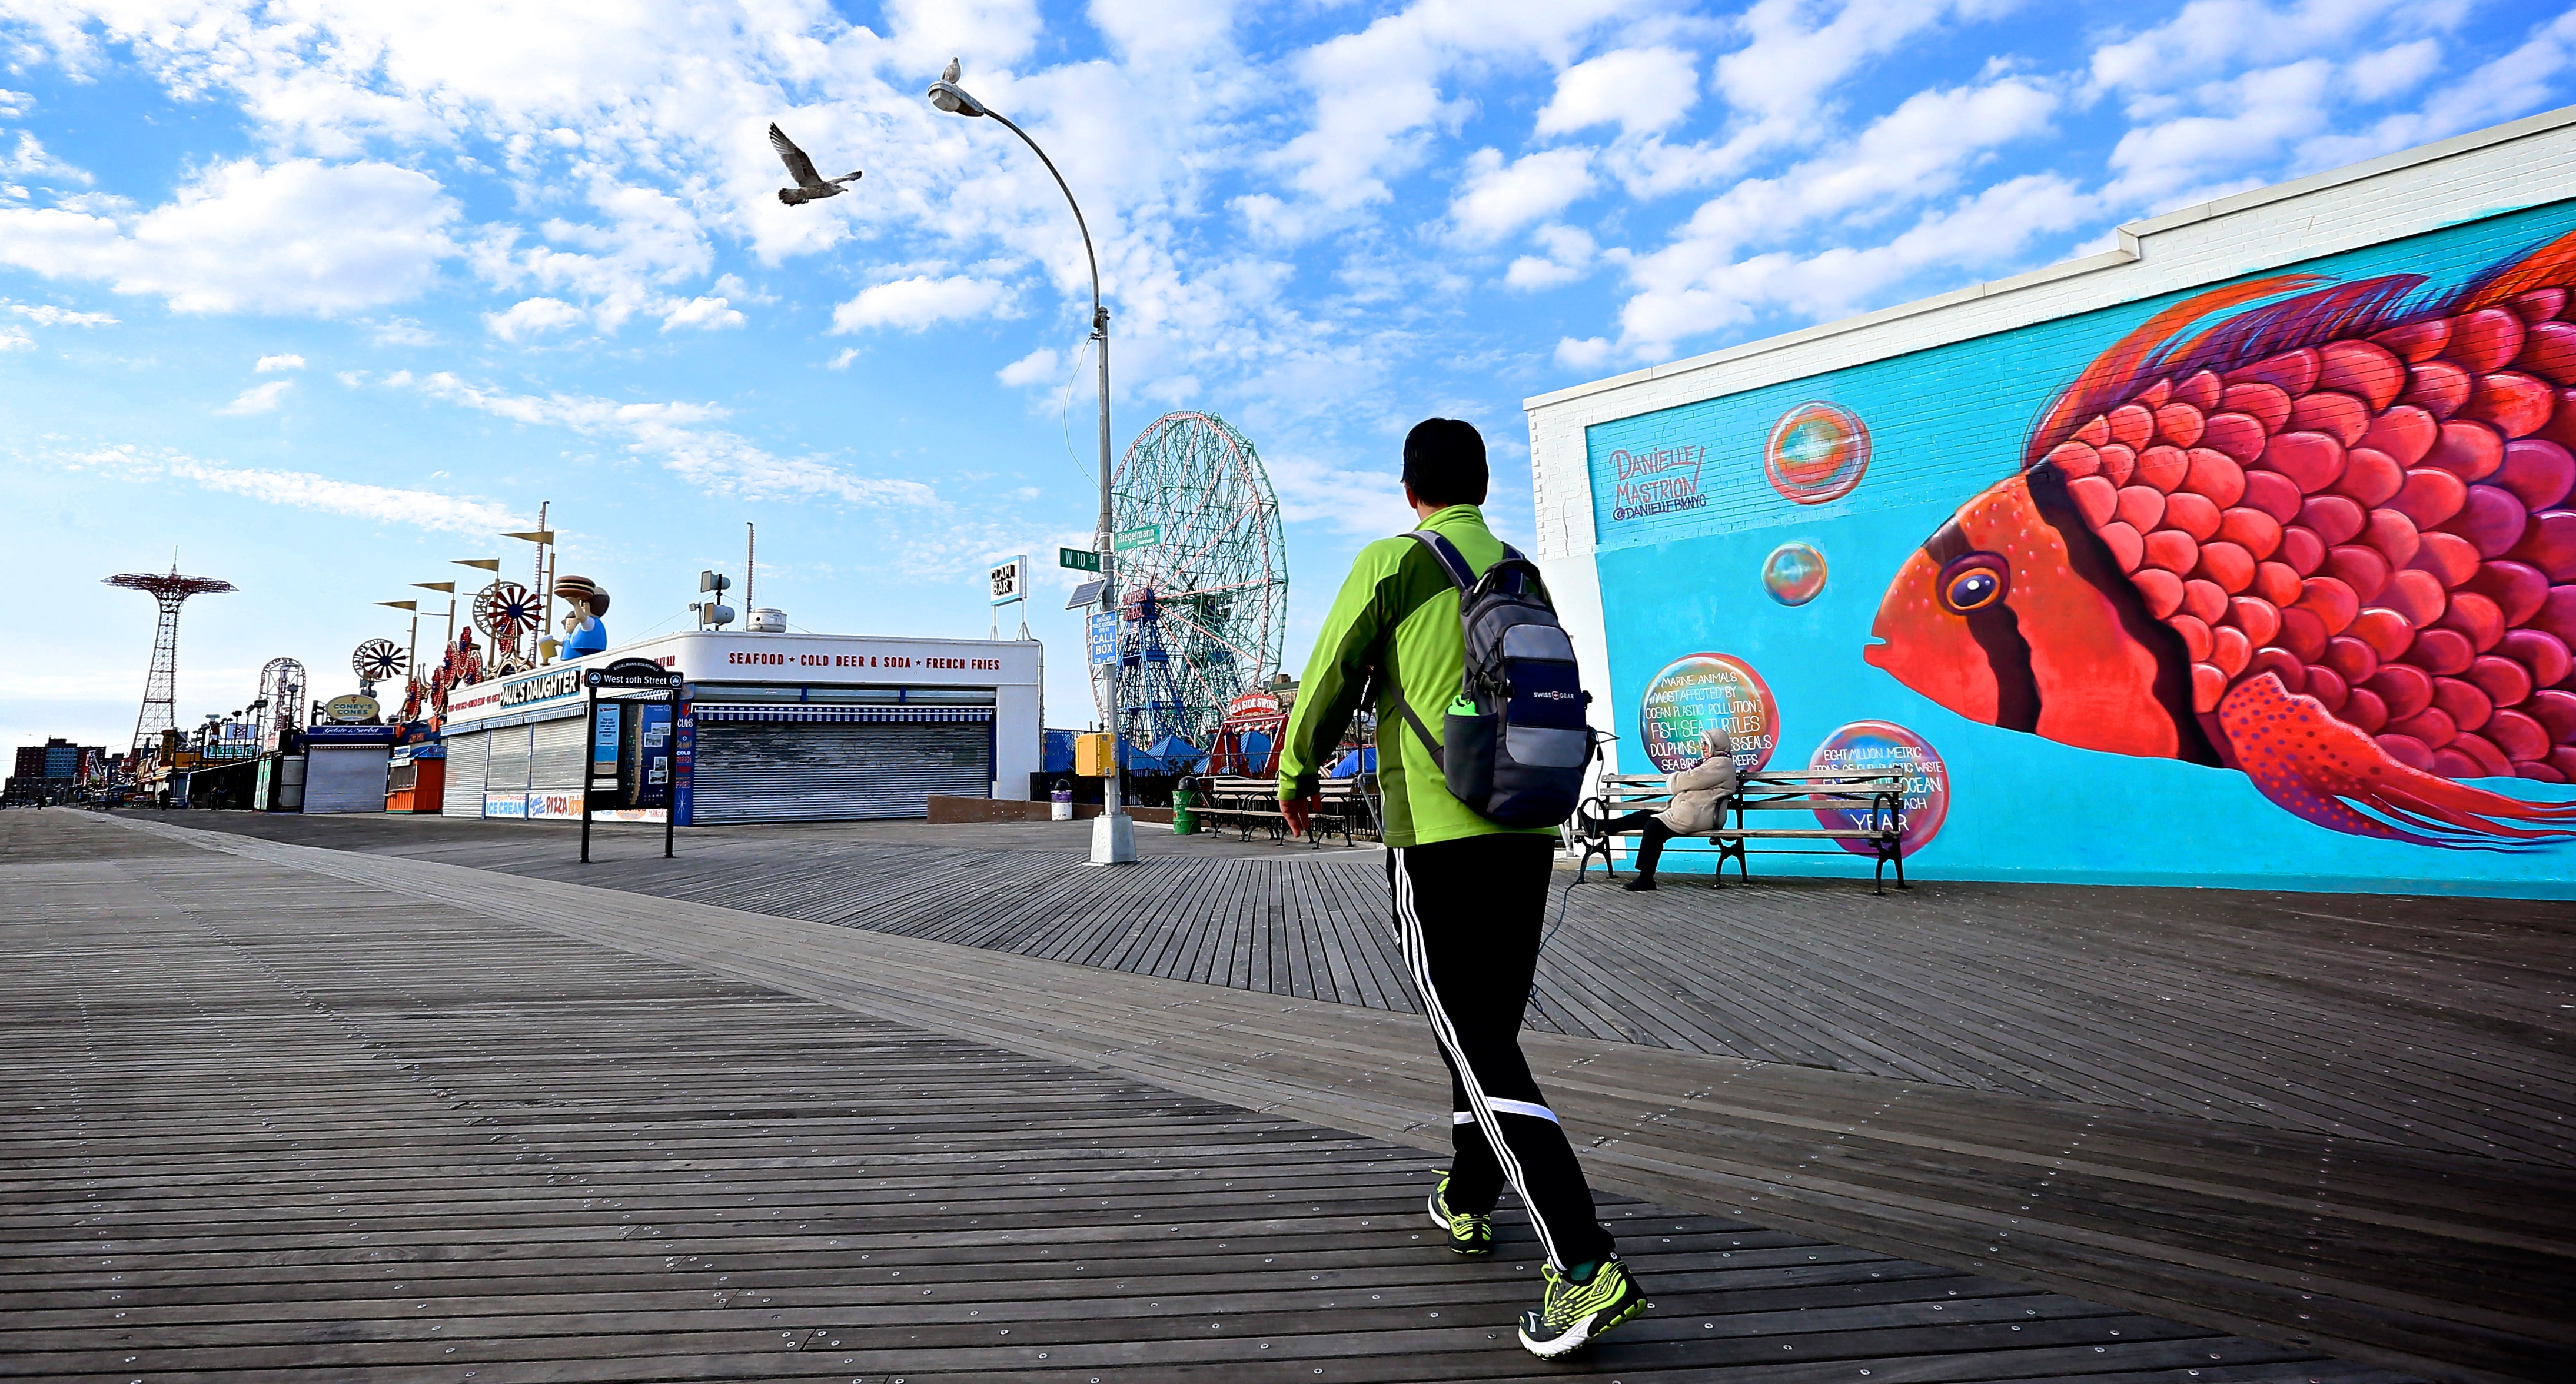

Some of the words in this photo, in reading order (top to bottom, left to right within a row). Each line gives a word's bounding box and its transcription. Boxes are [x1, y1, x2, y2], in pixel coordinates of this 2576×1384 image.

[1118, 528, 1154, 544] Riegelmann
[1065, 551, 1073, 565] W
[1076, 553, 1086, 567] 10
[1089, 555, 1096, 564] St
[990, 565, 1013, 581] CLAM
[993, 580, 1011, 595] BAR
[1093, 632, 1115, 644] CALL
[1096, 643, 1113, 655] BOX
[613, 662, 637, 670] RIEGELMANN
[637, 662, 659, 672] BOARDWALK
[729, 652, 784, 665] SEAFOOD
[801, 654, 829, 666] COLD
[836, 656, 865, 667] BEER
[870, 656, 877, 667] &
[884, 657, 911, 668] SODA
[926, 658, 965, 669] FRENCH
[971, 659, 999, 670] FRIES
[604, 675, 623, 683] West
[626, 675, 642, 684] 10th
[644, 676, 667, 684] Street
[1661, 675, 1694, 688] MARINE
[1698, 671, 1737, 684] ANIMALS
[500, 683, 526, 706] PAUL'S
[526, 670, 576, 701] DAUGHTER
[1649, 690, 1678, 704] MOST
[1680, 687, 1722, 701] AFFECTED
[1725, 686, 1736, 698] BY
[1229, 703, 1242, 716] SEA
[1242, 698, 1256, 710] SIDE
[1257, 698, 1278, 711] SWING
[1646, 707, 1671, 719] OCEAN
[1674, 704, 1704, 717] PLASTIC
[677, 718, 693, 727] CLAMS
[1706, 716, 1760, 733] TURTLES
[1824, 749, 1847, 761] EIGHT
[1849, 748, 1883, 760] MILLION
[1887, 747, 1922, 758] METRIC
[1661, 759, 1677, 771] SEA
[1733, 754, 1759, 766] REEFS
[1916, 761, 1943, 773] WASTE
[1900, 777, 1942, 794] OCEAN
[487, 802, 498, 814] ICE
[499, 802, 525, 815] CREAM
[547, 796, 567, 816] PIZZA
[1899, 797, 1927, 809] ACH
